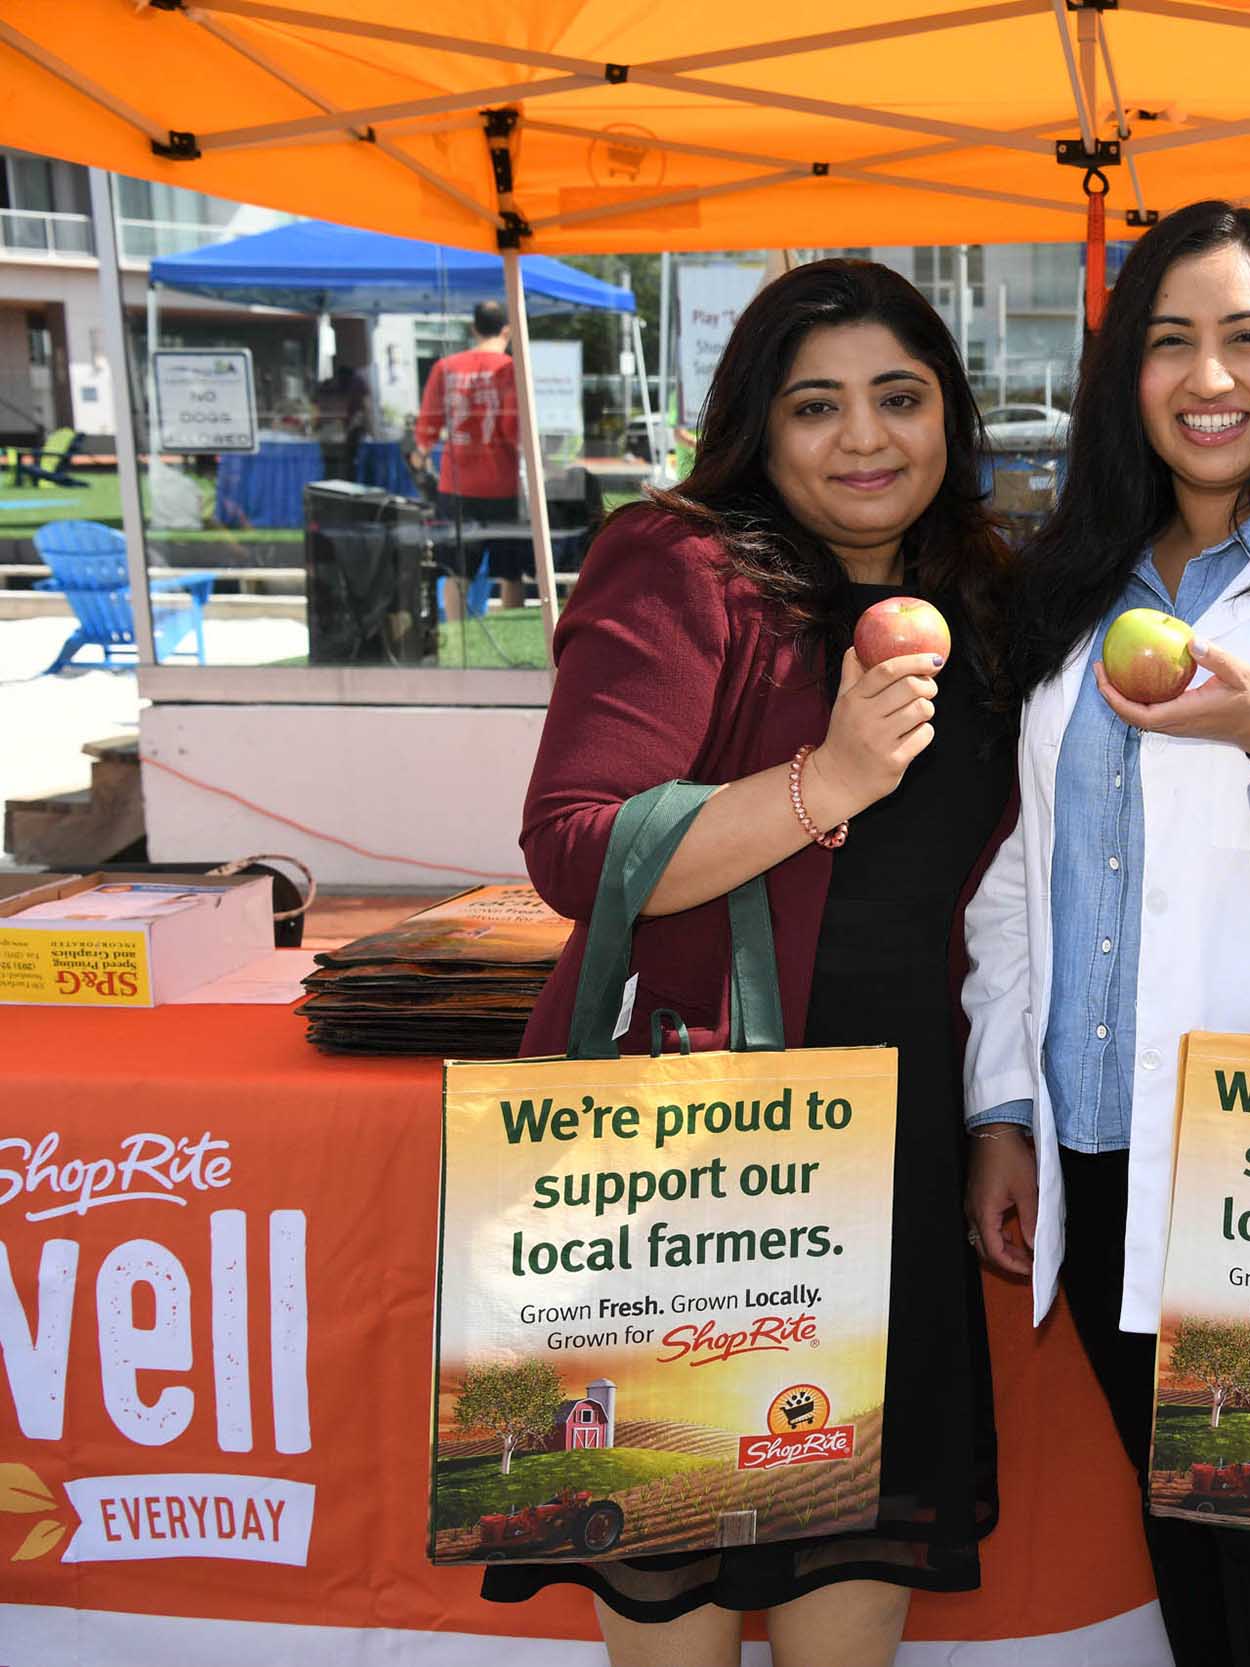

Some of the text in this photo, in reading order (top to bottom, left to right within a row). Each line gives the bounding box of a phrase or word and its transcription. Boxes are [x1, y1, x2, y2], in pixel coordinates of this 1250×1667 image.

[51, 949, 136, 960] and Graphics
[52, 958, 137, 971] Speed Printing
[57, 970, 138, 997] SP&G
[501, 1088, 853, 1147] We're proud to
[0, 1131, 232, 1222] ShopRite
[533, 1158, 820, 1216] support our
[512, 1222, 844, 1276] local farmers.
[520, 1285, 822, 1324] Grown Fresh. Grown Locally.
[547, 1330, 618, 1351] Grown
[624, 1327, 655, 1346] for
[100, 1496, 285, 1542] EVERYDAY
